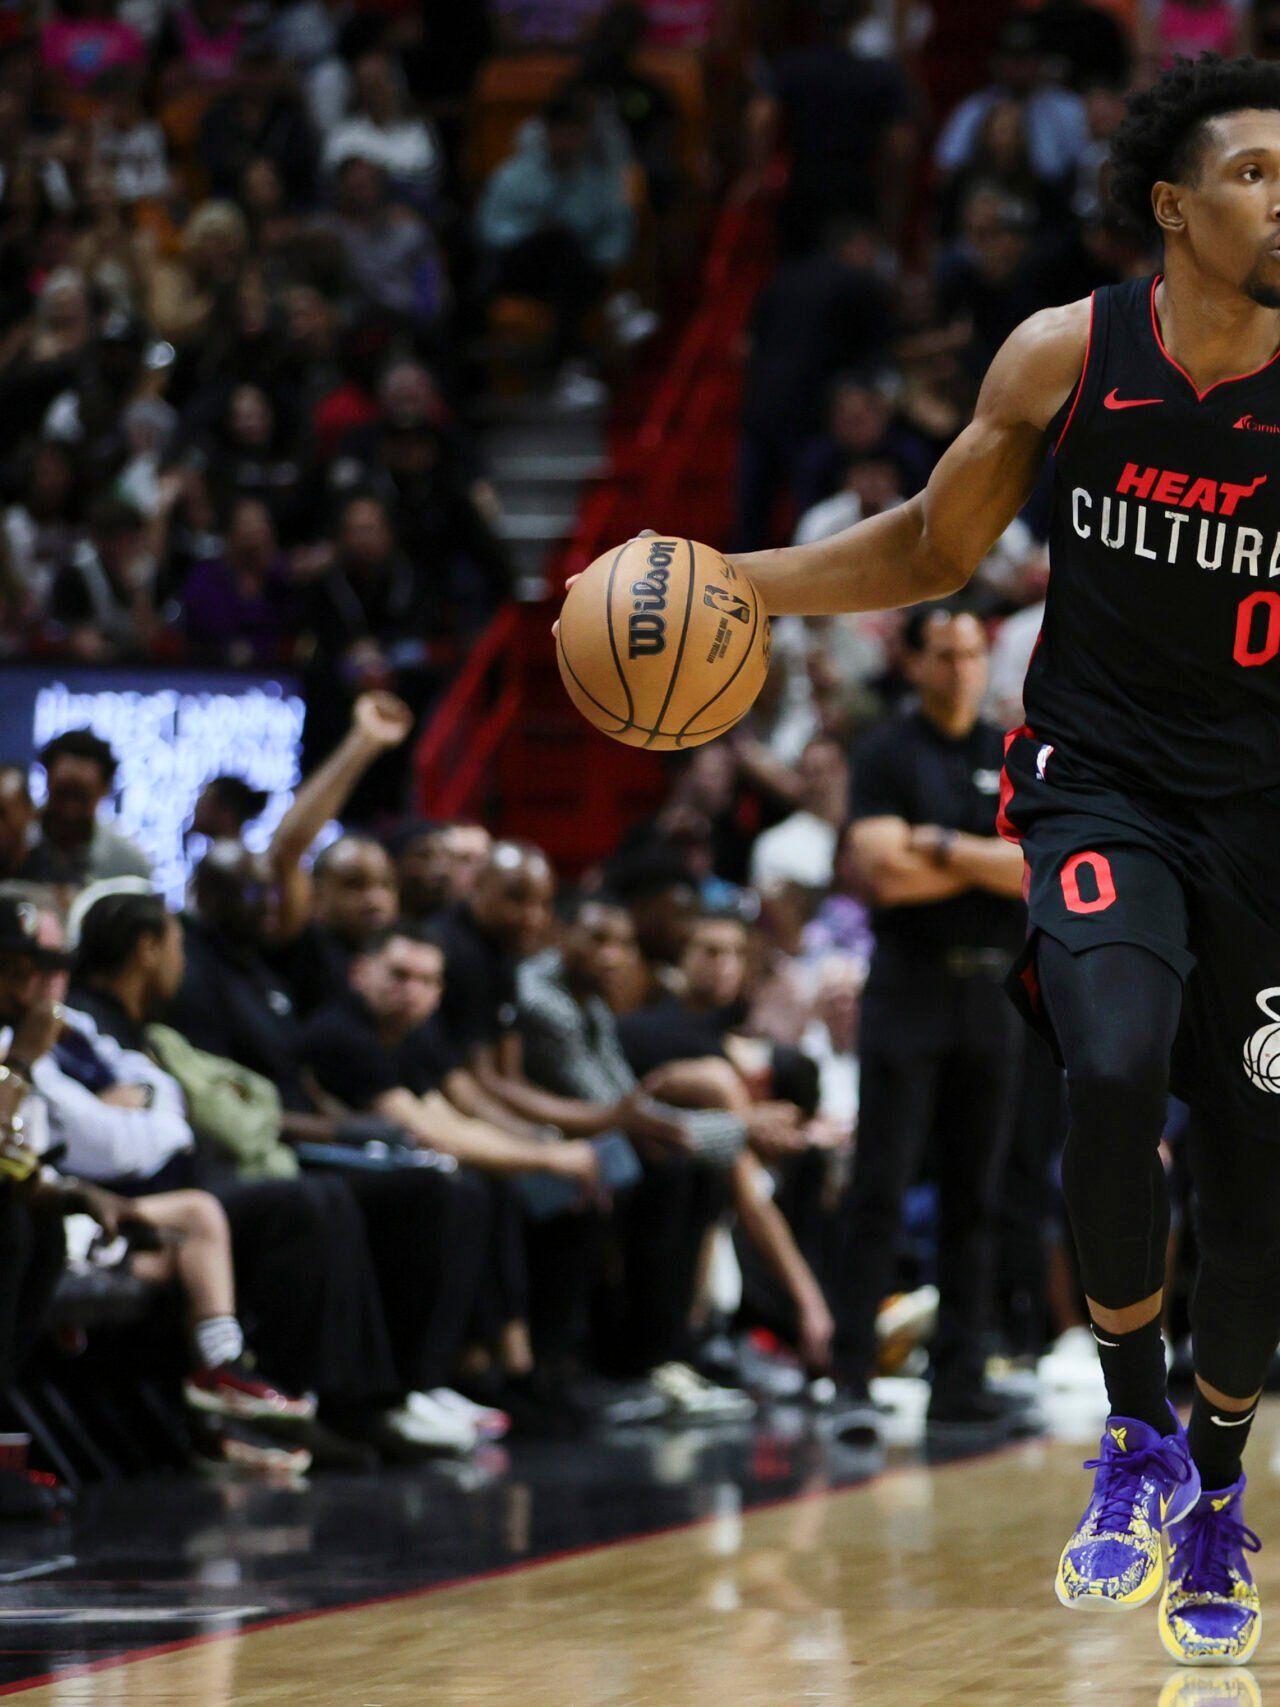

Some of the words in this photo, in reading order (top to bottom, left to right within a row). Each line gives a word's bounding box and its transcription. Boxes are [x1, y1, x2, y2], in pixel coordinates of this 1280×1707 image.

[1115, 462, 1268, 516] HEAT
[628, 541, 678, 660] Wilson
[1060, 850, 1117, 914] 0
